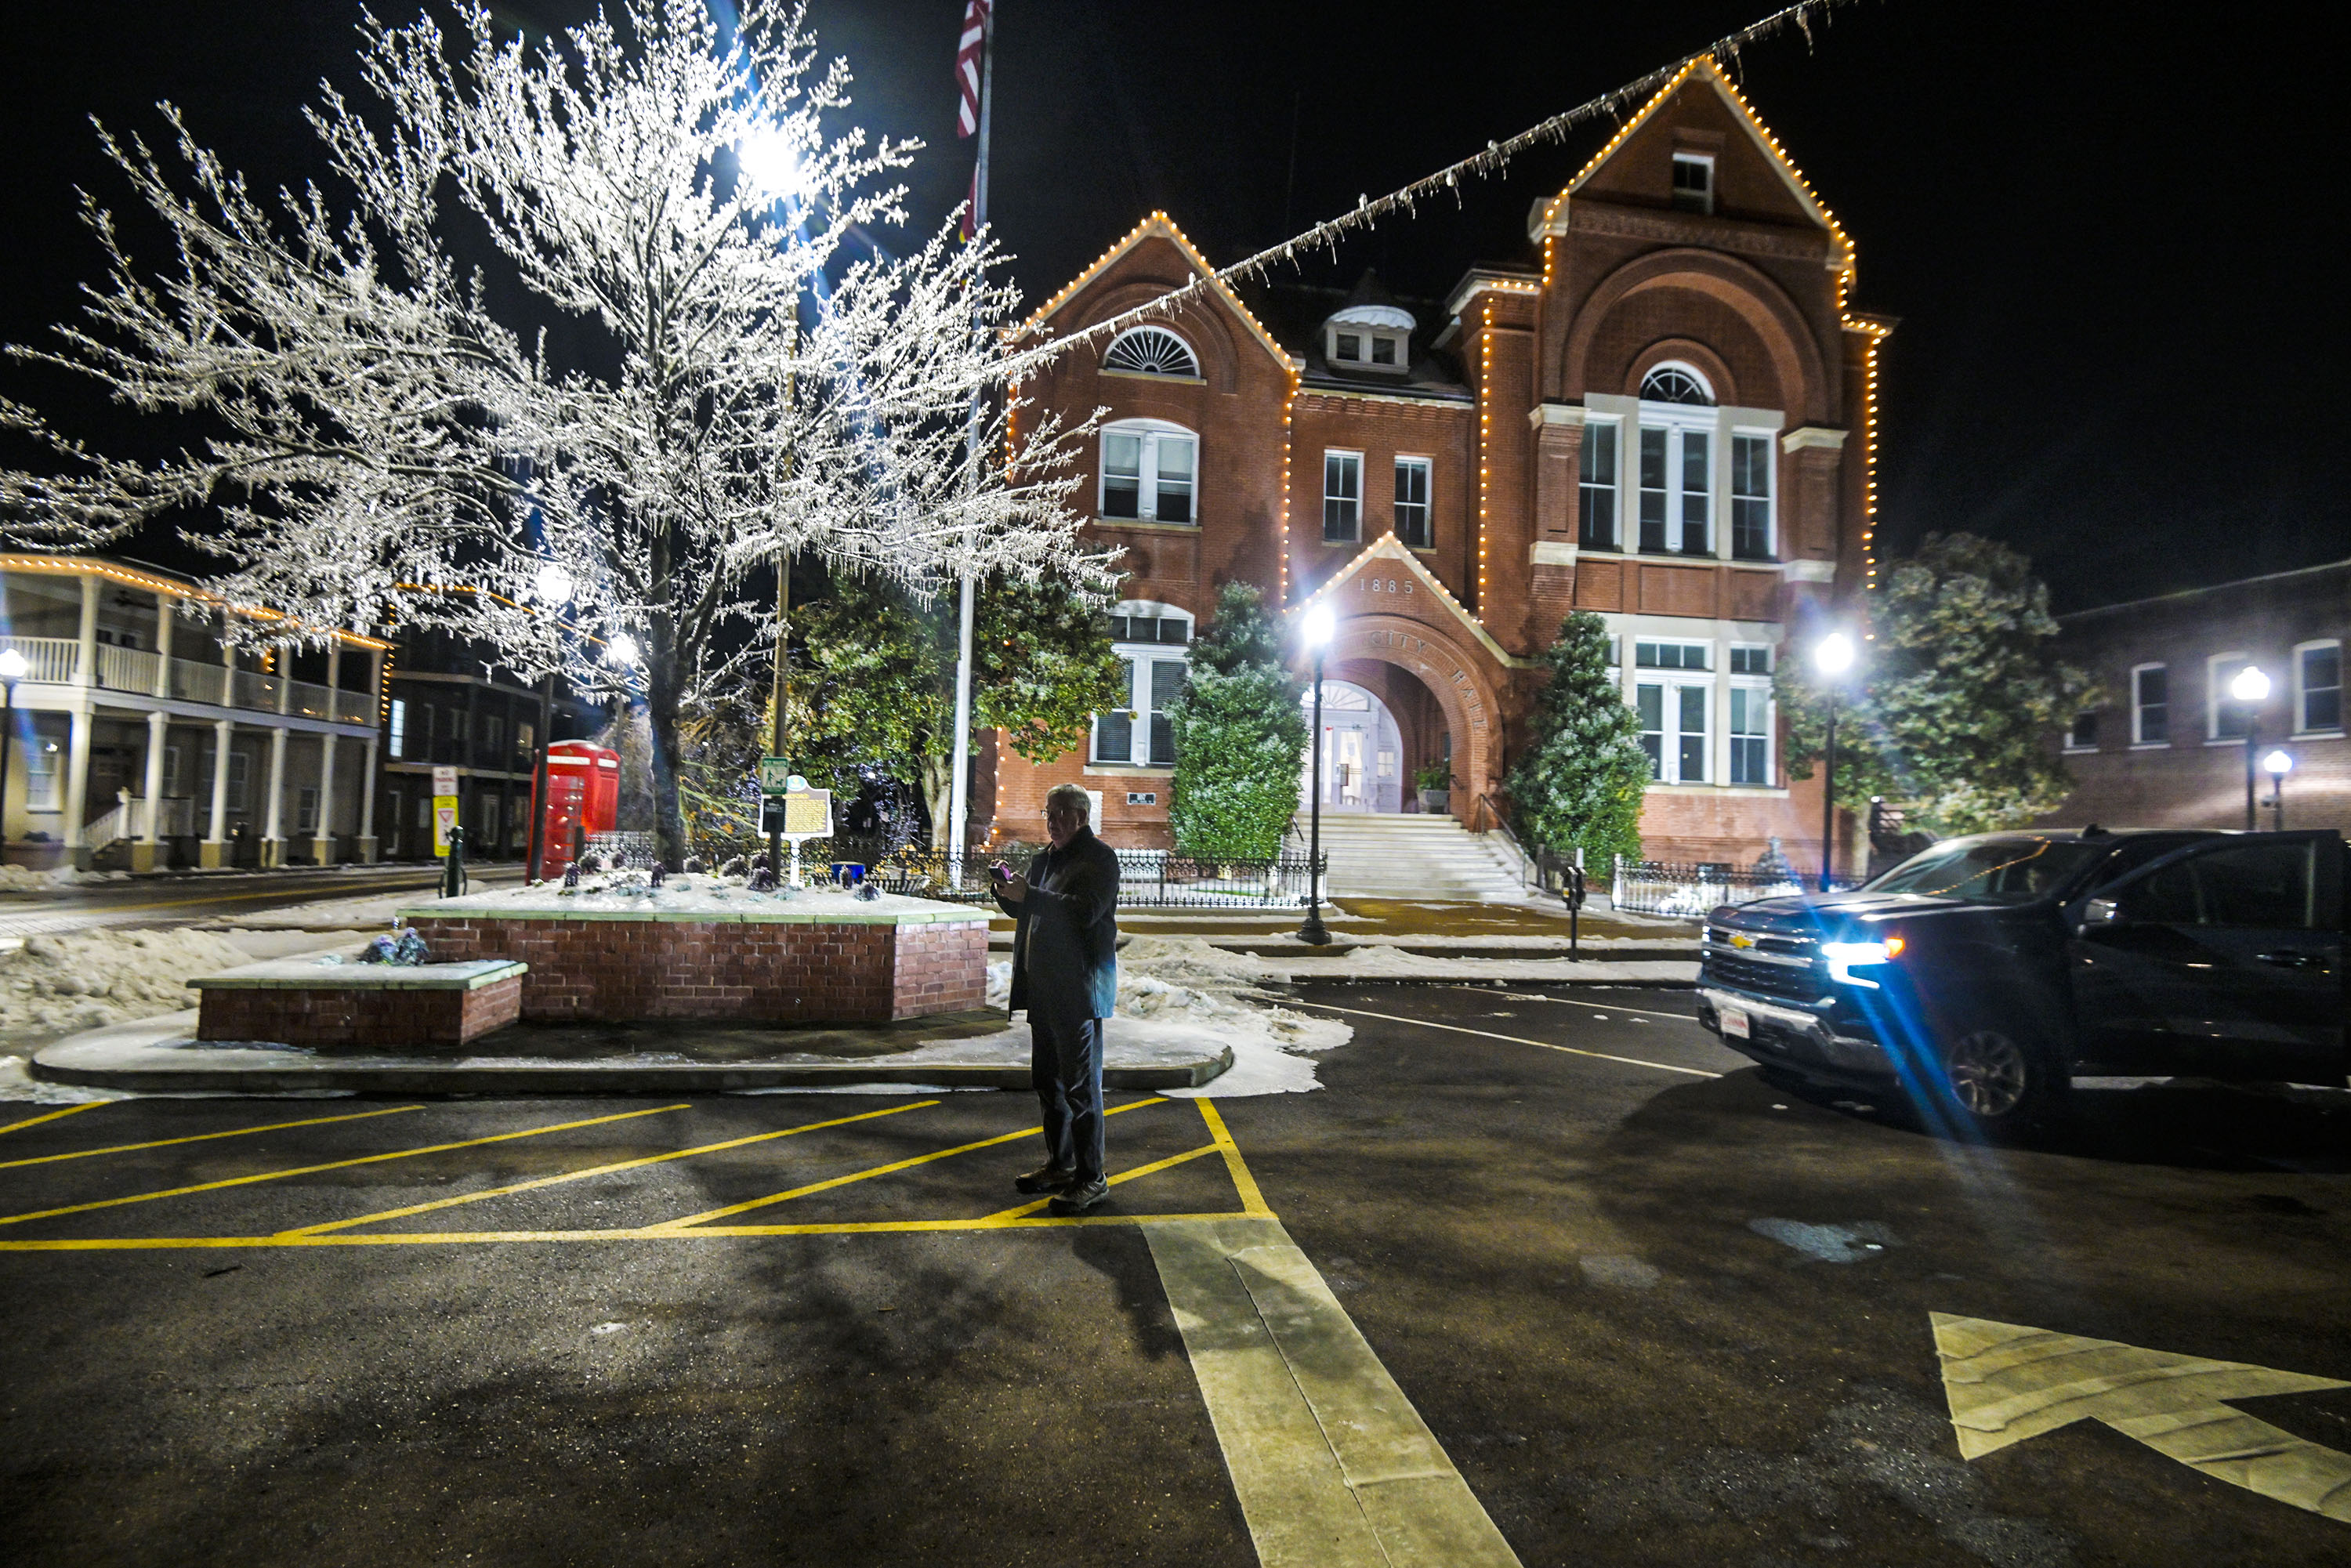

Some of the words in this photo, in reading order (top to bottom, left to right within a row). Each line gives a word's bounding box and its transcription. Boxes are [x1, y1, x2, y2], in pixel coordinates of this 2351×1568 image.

[1360, 578, 1413, 594] 1885
[1371, 631, 1425, 653] CITY
[1451, 670, 1487, 730] HALL
